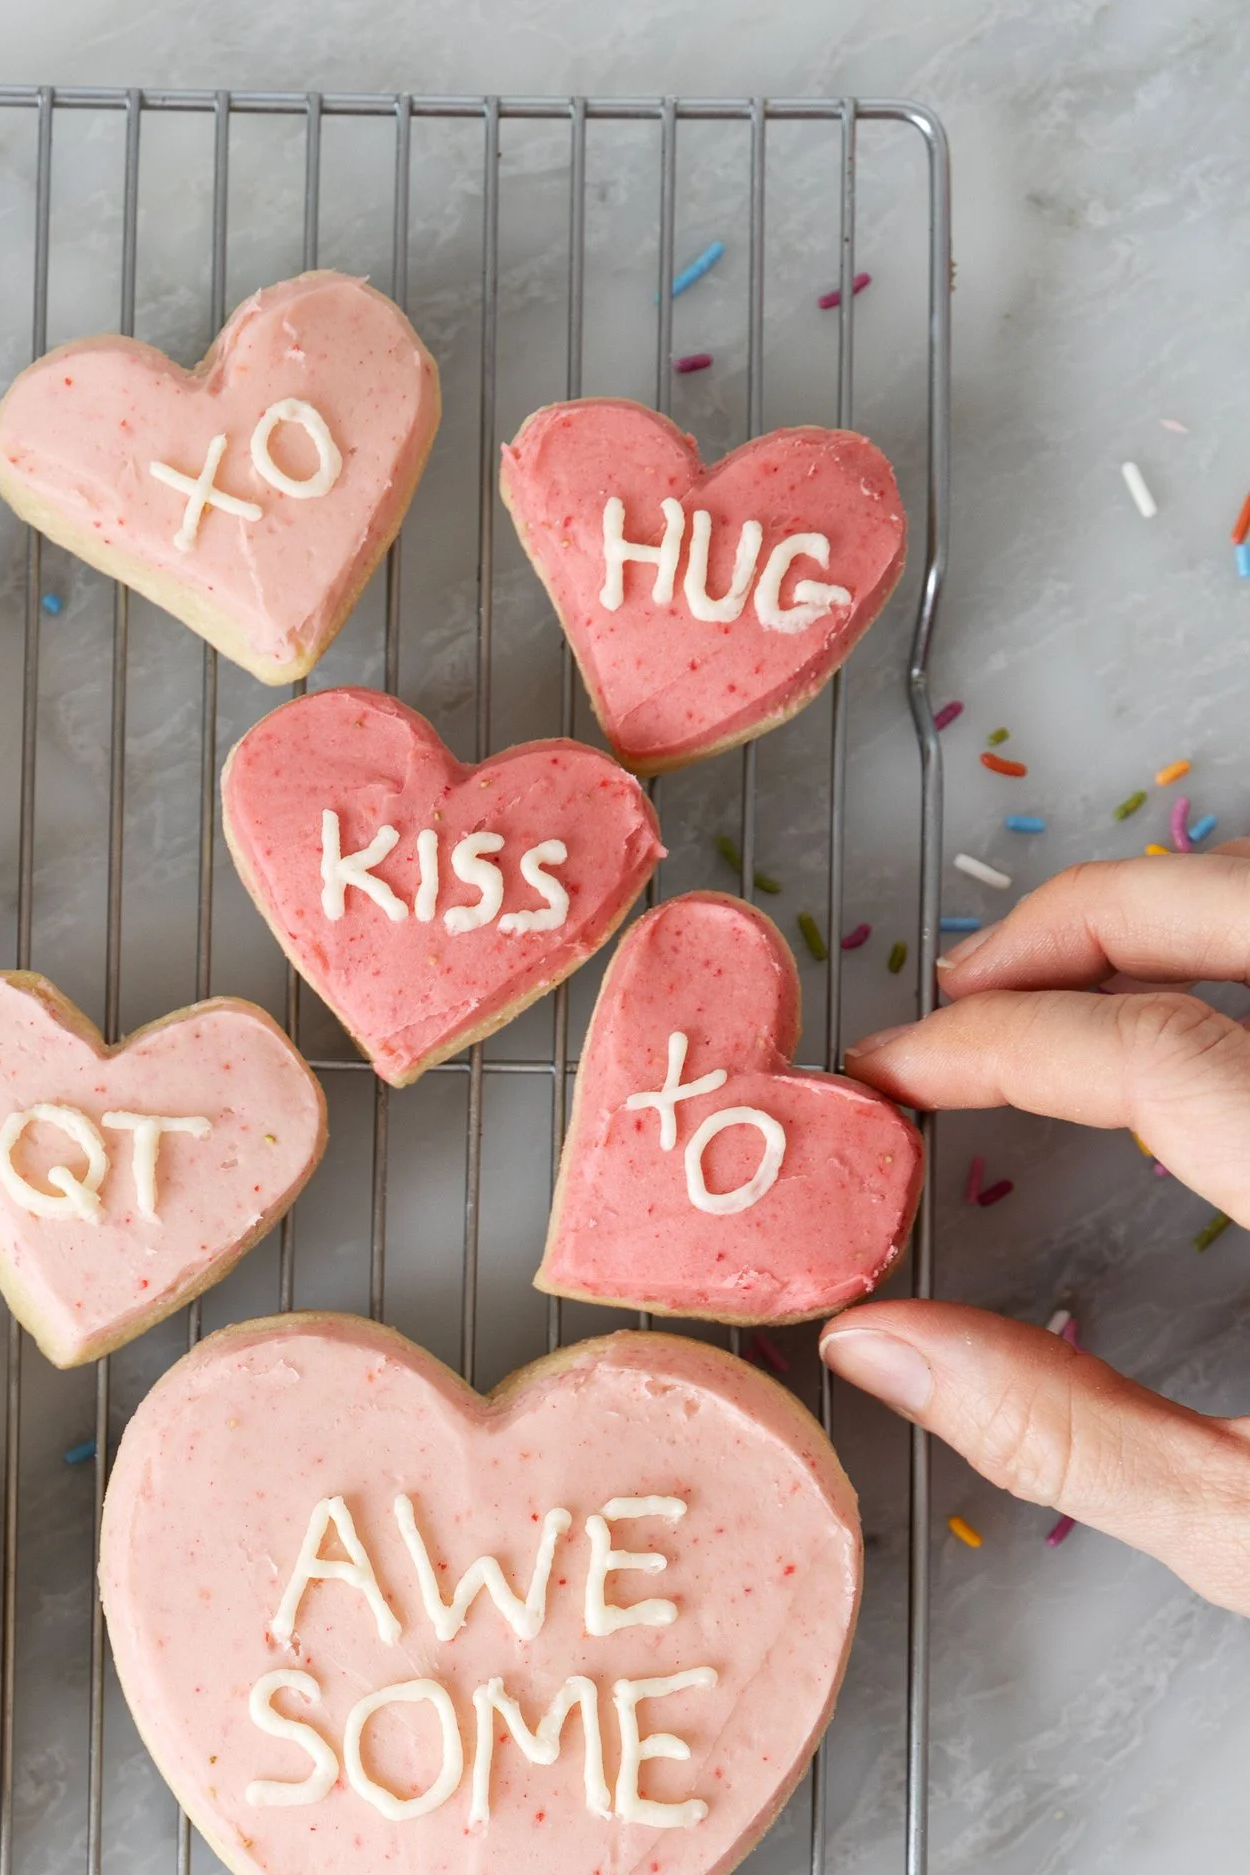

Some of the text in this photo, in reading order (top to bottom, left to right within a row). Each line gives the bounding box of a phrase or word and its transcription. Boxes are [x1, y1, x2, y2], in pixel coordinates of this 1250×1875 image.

[151, 397, 342, 549] XO
[599, 496, 852, 633] HUG
[321, 808, 568, 935] KISS
[626, 1032, 787, 1215] XO
[271, 1494, 687, 1645] AWE
[246, 1666, 719, 1832] SOME
